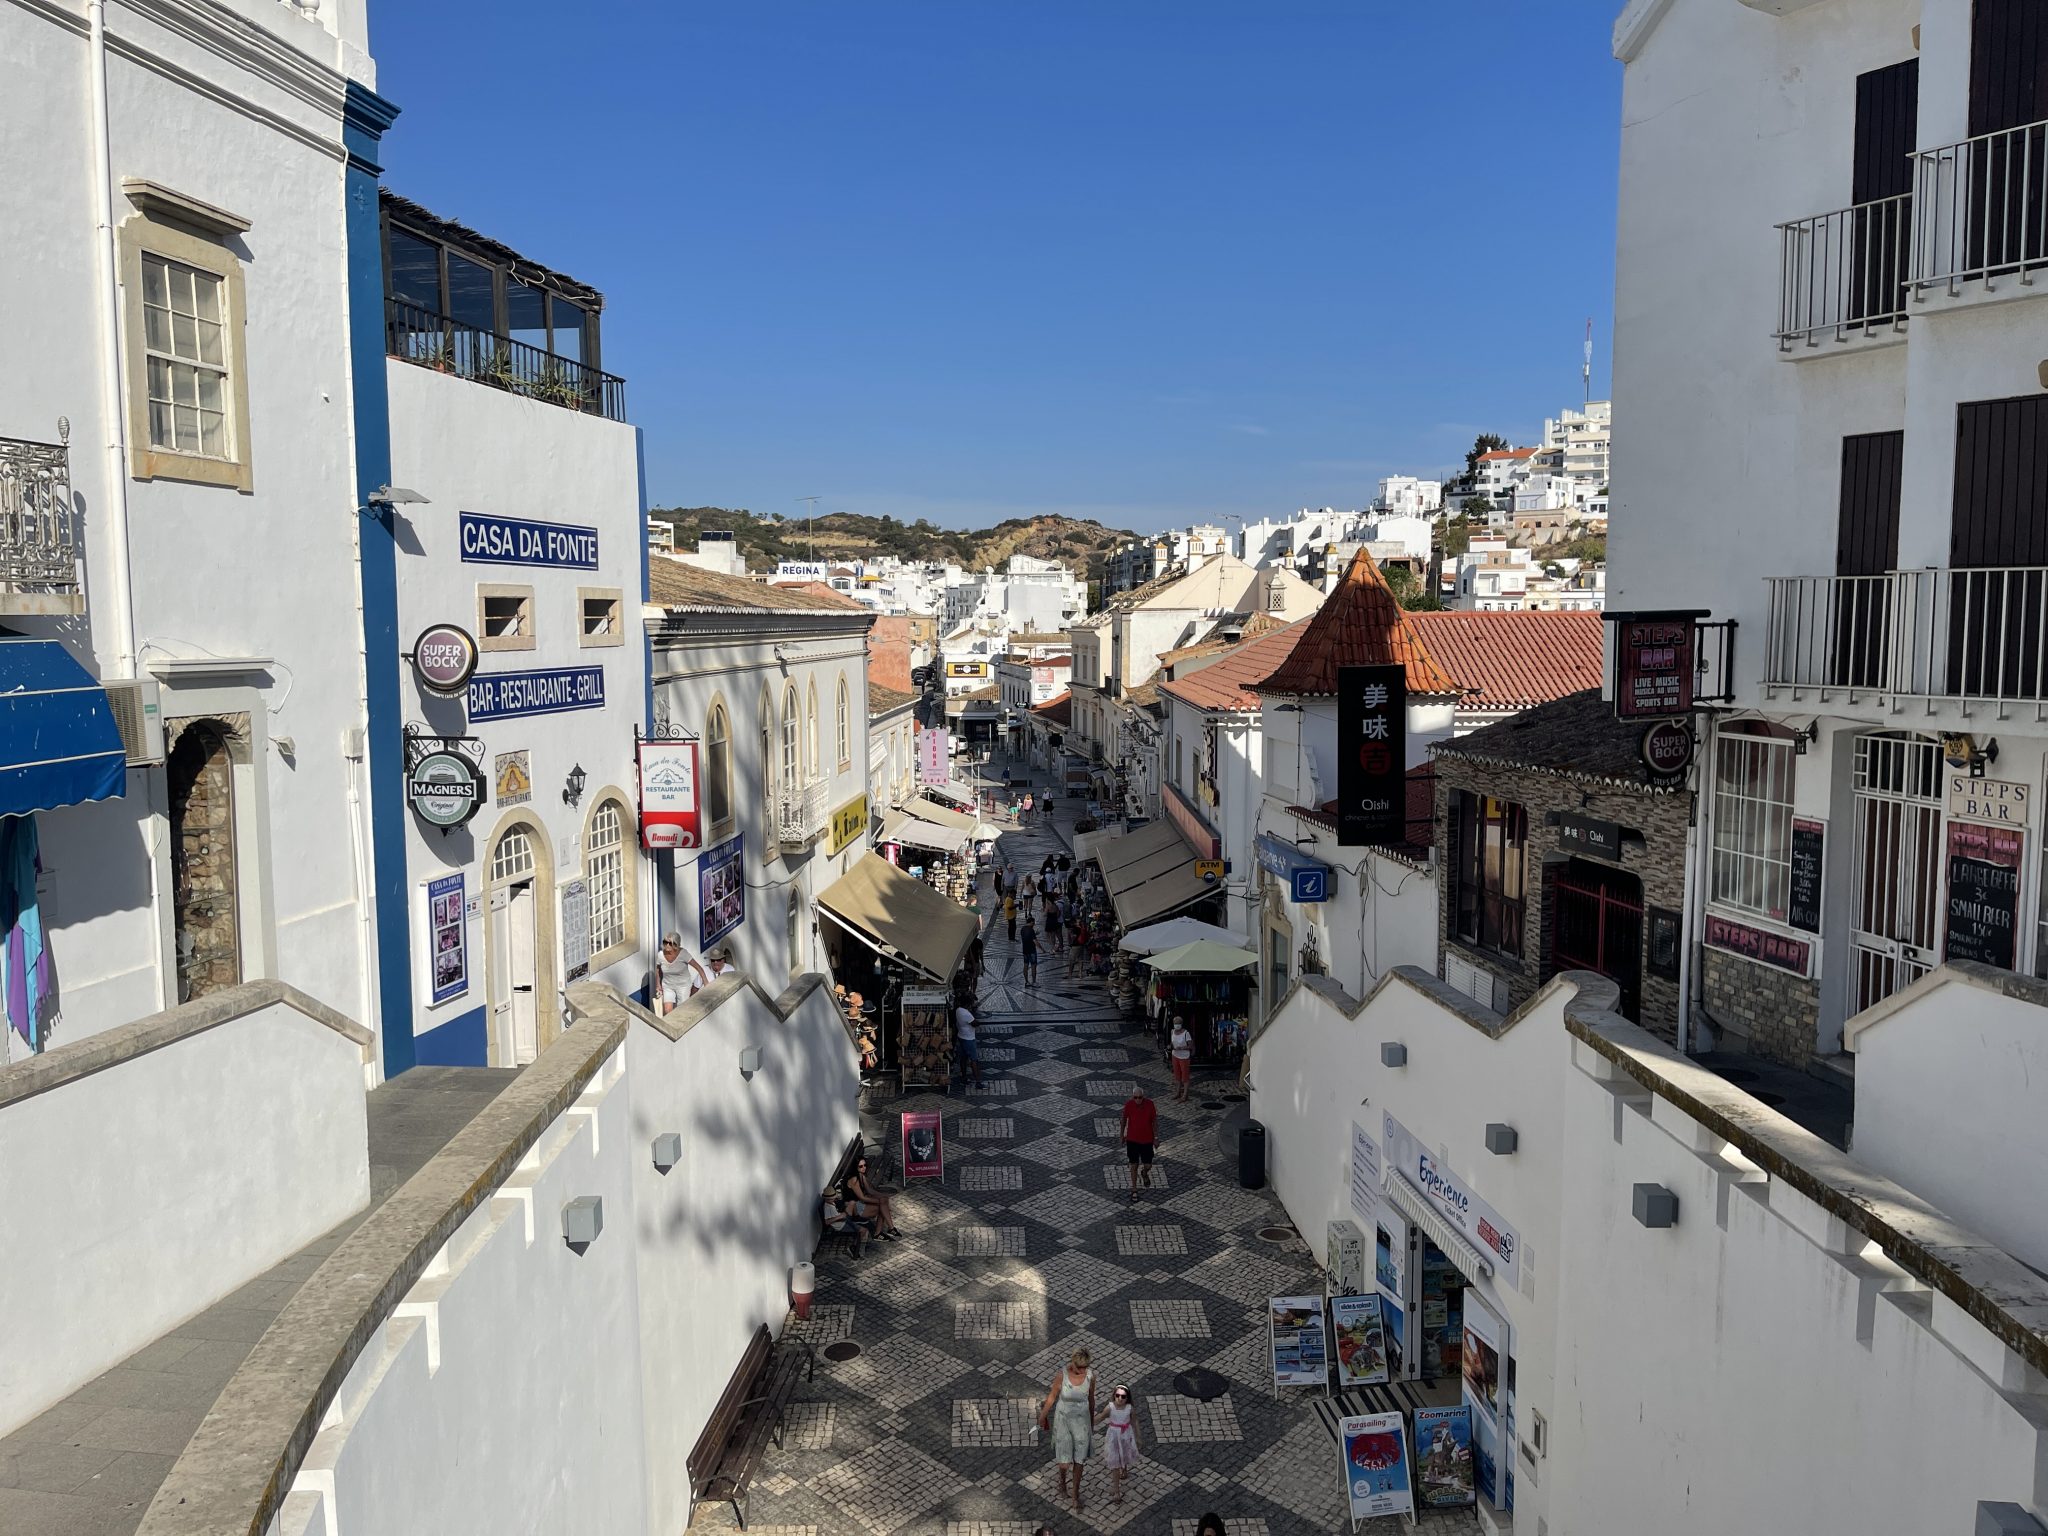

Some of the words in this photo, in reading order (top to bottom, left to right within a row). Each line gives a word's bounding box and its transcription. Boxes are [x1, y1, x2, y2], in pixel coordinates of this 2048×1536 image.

[463, 522, 515, 556] CASA
[519, 528, 544, 559] DA
[548, 532, 597, 563] FONTE
[782, 566, 820, 575] REGINA
[1631, 622, 1687, 646] STEPS
[423, 644, 461, 657] SUPER
[1640, 648, 1675, 671] BAR
[424, 656, 459, 668] BOCK
[1634, 677, 1652, 688] LIVE
[1655, 675, 1680, 687] MUSIC
[1635, 697, 1661, 708] SPORTS
[1663, 696, 1678, 706] BAR
[1363, 683, 1390, 740] 美味
[1652, 735, 1686, 749] SUPER
[1655, 746, 1685, 759] BOCK
[660, 756, 670, 765] da
[671, 758, 691, 774] Fonte
[413, 783, 473, 796] MAGNERS
[1953, 778, 2026, 801] STEPS
[1361, 798, 1390, 811] Oishi
[1966, 799, 2009, 819] BAR
[1953, 831, 1989, 850] STEPS
[1952, 861, 1990, 888] LARGE
[1990, 869, 2017, 892] BEER
[1791, 904, 1804, 922] AIR
[1950, 898, 1981, 922] SMALL
[1983, 905, 2011, 929] BEER
[1713, 921, 1760, 951] STEPS
[1765, 938, 1800, 963] BAR
[1419, 1154, 1469, 1213] Experience
[1418, 1410, 1467, 1419] Zoomarine
[1347, 1419, 1387, 1429] Parasailing
